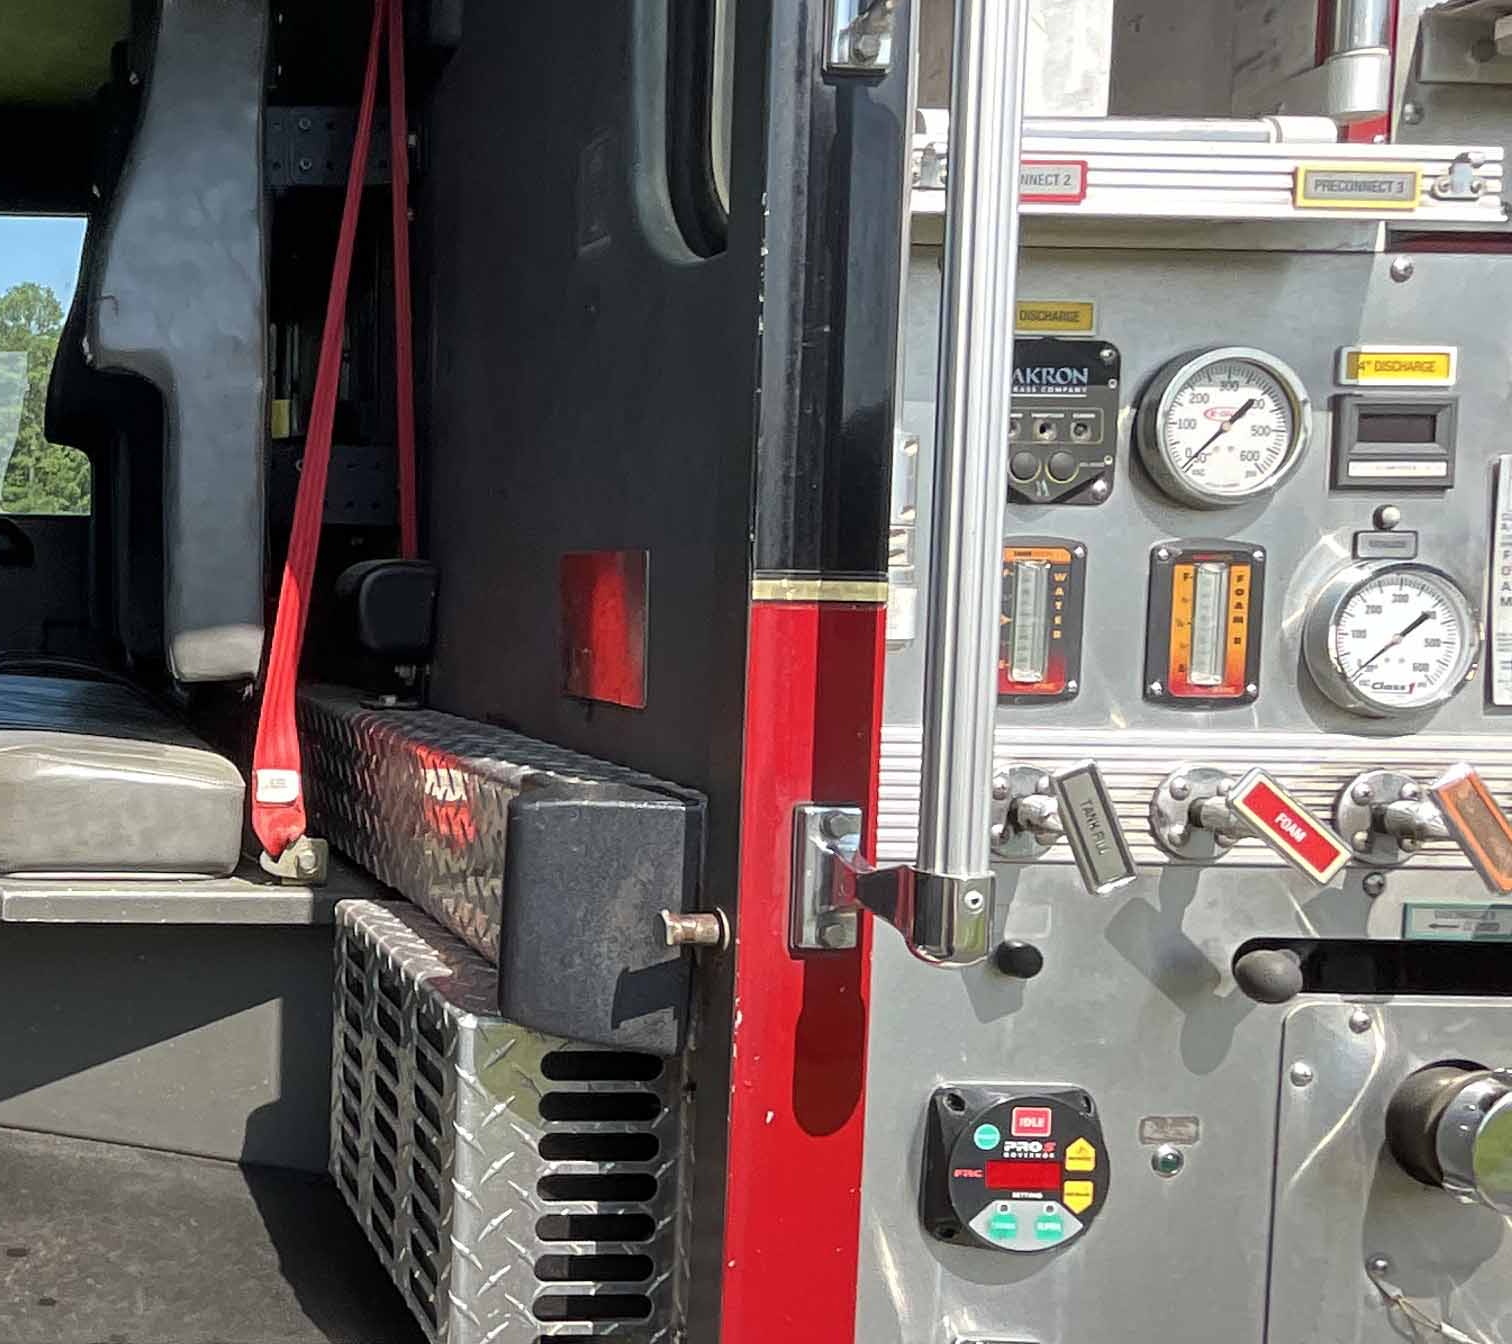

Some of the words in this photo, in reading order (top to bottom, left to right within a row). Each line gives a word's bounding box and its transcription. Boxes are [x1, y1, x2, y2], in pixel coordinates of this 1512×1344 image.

[1314, 179, 1394, 193] PRECONNECT
[1395, 181, 1404, 193] 3
[1019, 310, 1080, 323] DISCHARGE
[1374, 361, 1436, 372] DISCHARGE
[1013, 367, 1088, 384] AKRON
[1189, 393, 1210, 404] 200
[1178, 419, 1197, 429] 100
[1251, 426, 1271, 436] 500
[1240, 451, 1260, 461] 600
[1080, 799, 1100, 834] TANK
[1274, 811, 1307, 843] FOAM
[1019, 1117, 1046, 1128] IDLE
